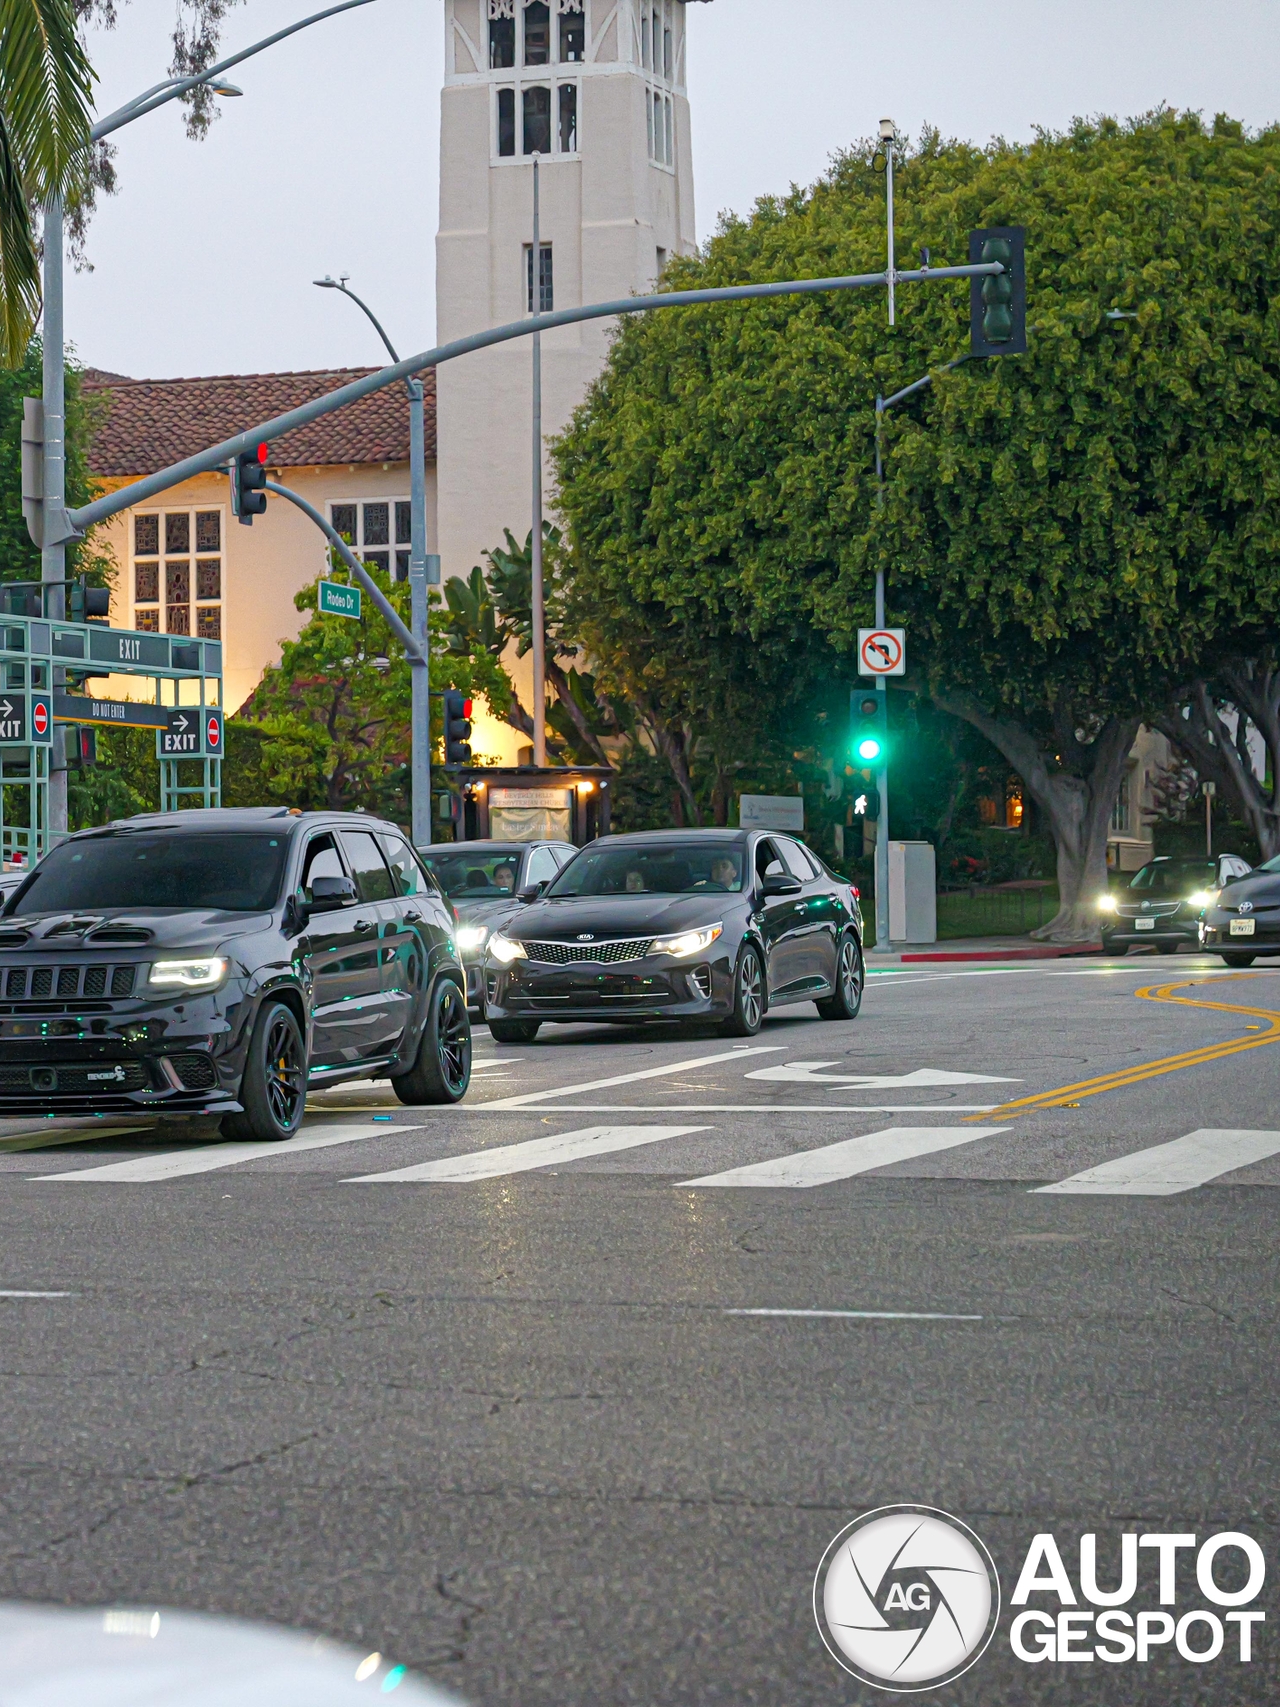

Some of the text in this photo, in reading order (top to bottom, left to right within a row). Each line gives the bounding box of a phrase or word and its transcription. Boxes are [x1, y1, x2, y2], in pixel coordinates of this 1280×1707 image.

[327, 590, 354, 609] Rodeo Dr
[119, 638, 140, 660] EXIT
[92, 703, 125, 719] DO NOT ENTER
[164, 734, 196, 751] EXIT
